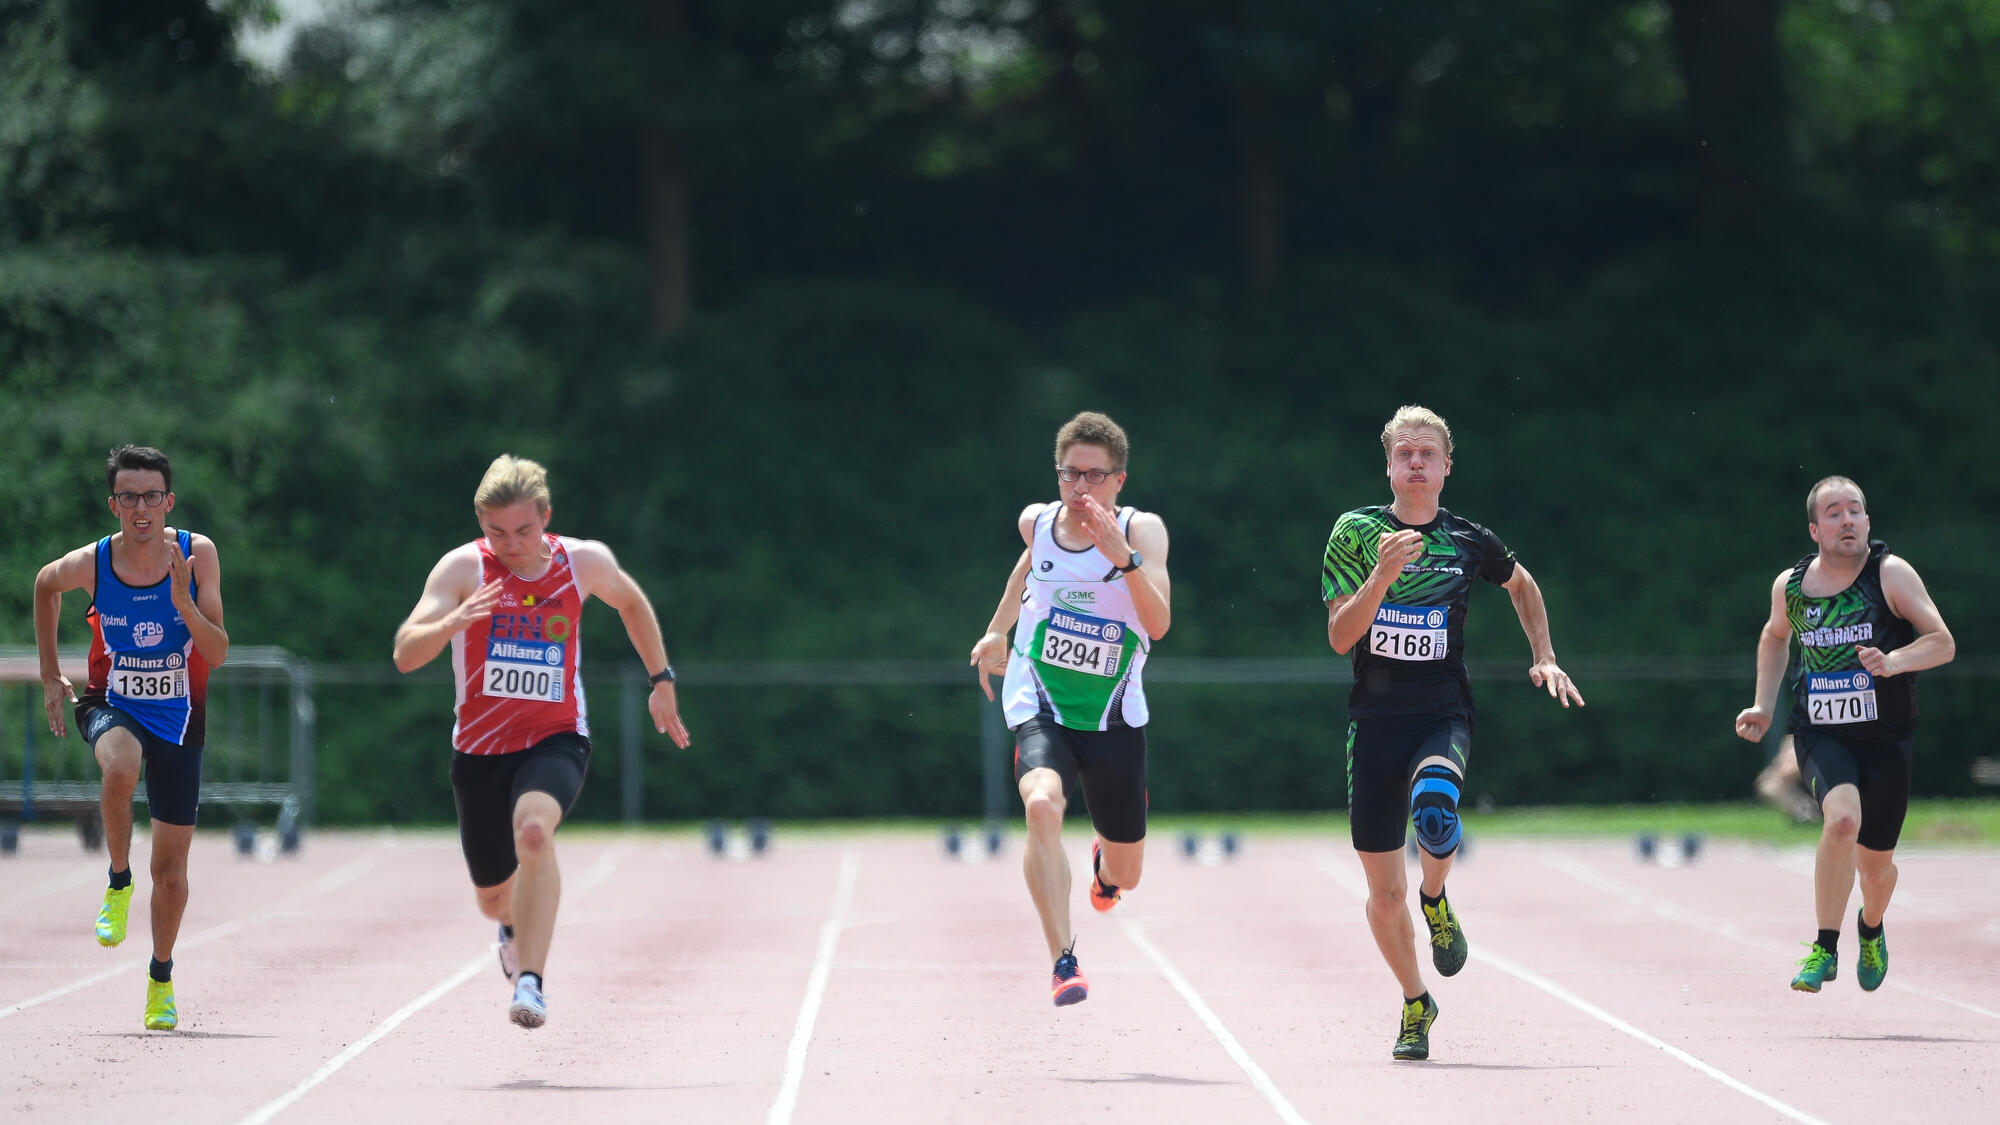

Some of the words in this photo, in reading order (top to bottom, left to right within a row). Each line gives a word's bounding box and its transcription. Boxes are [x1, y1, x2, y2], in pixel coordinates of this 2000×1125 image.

[1065, 591, 1095, 600] JSMC
[1050, 613, 1100, 636] Allianz
[1376, 608, 1425, 625] Allianz
[1375, 631, 1432, 657] 2168
[1834, 622, 1873, 645] RACER
[491, 643, 544, 660] Allianz
[1045, 635, 1101, 670] 3294
[118, 656, 164, 669] Allianz
[1107, 657, 1116, 675] 2022
[118, 675, 171, 696] 1336
[489, 668, 549, 696] 2000
[1810, 677, 1851, 690] Allianz
[1812, 697, 1862, 721] 2170
